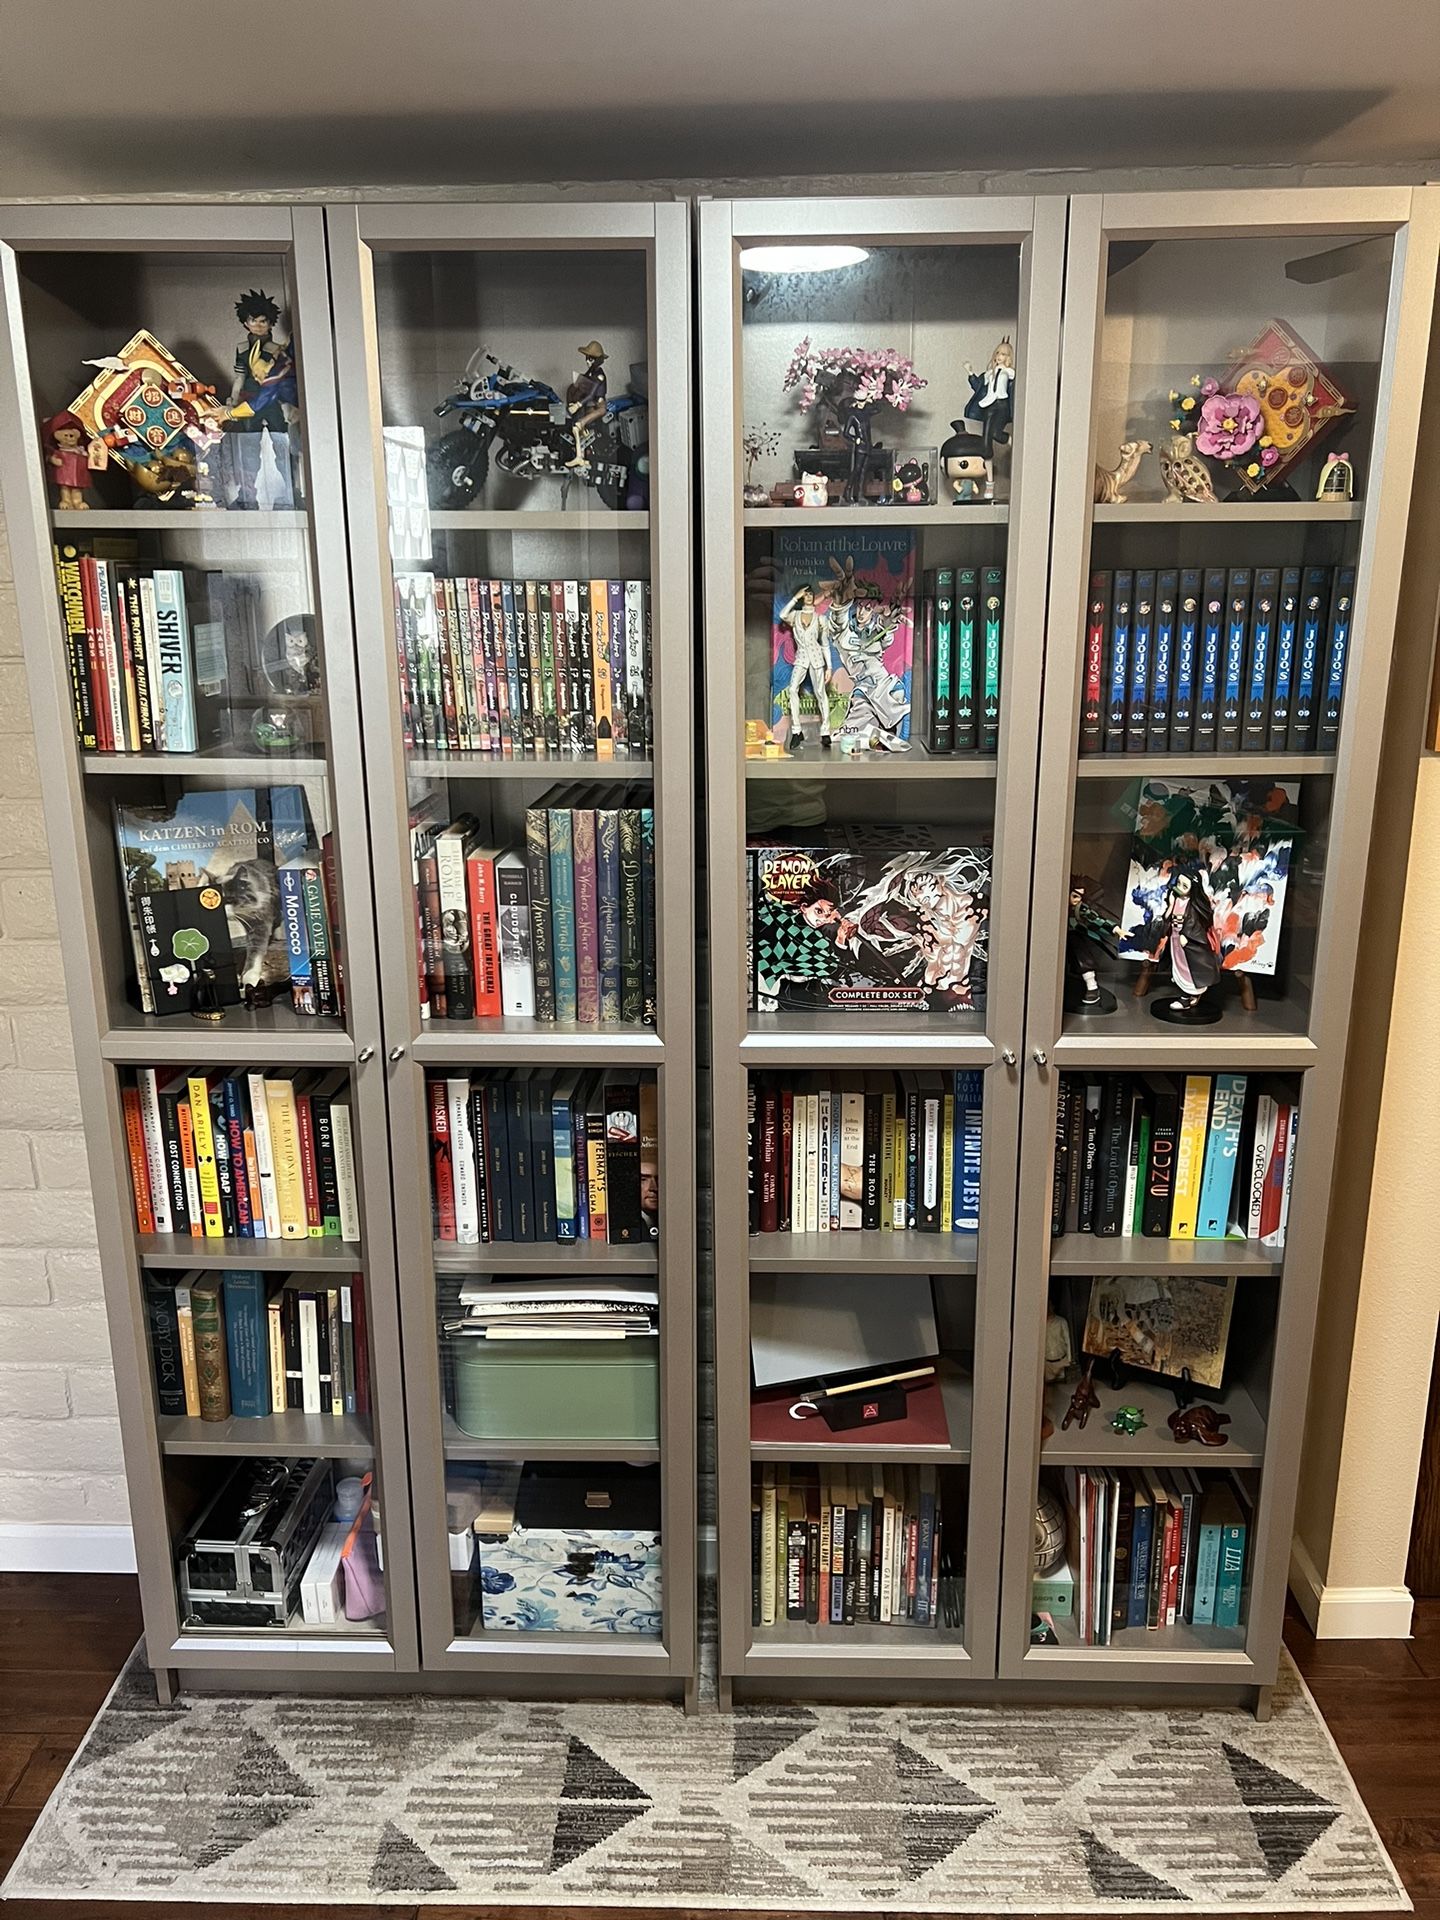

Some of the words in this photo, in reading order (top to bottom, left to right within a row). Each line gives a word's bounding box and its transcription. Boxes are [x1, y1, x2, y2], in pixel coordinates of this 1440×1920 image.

[780, 537, 821, 551] Rohan
[823, 538, 833, 551] at
[833, 537, 860, 551] the
[862, 537, 906, 551] Louvre
[785, 558, 824, 566] Hirohiko
[66, 562, 86, 633] WATCHMEN
[129, 595, 138, 616] THE
[98, 566, 107, 611] PEANUTS
[107, 645, 115, 678] FOREVER
[86, 628, 95, 657] MAUS
[130, 616, 143, 659] PROPHET
[157, 611, 182, 674] SHIVER
[938, 709, 948, 718] 01
[959, 709, 971, 717] 02
[985, 708, 997, 717] 03
[84, 735, 95, 746] DC
[138, 825, 206, 841] KATZEN
[211, 826, 225, 836] in
[229, 822, 267, 834] ROM
[171, 842, 214, 851] CIMITERO
[440, 854, 453, 899] ROME
[764, 860, 812, 873] DEMON
[621, 860, 640, 927] Dinosaurs
[762, 874, 812, 890] SLAYER
[307, 884, 321, 915] GAME
[285, 895, 301, 955] Morocco
[482, 912, 490, 925] THE
[531, 898, 549, 951] Universe
[553, 898, 574, 952] Animals
[601, 896, 617, 935] Aquatic
[312, 918, 326, 957] OVER
[484, 928, 492, 951] GREAT
[603, 935, 617, 955] Life
[485, 953, 495, 994] INFLUENZA
[836, 991, 881, 999] COMPLETE
[883, 991, 901, 999] BOX
[903, 991, 919, 999] SET
[193, 1085, 201, 1109] DAN
[433, 1085, 447, 1132] UNMASKED
[1056, 1080, 1066, 1119] HARPER
[1115, 1082, 1123, 1115] FARMER
[1184, 1088, 1197, 1131] DARK
[1211, 1089, 1229, 1129] END
[282, 1103, 290, 1126] THE
[765, 1101, 774, 1124] Blood
[783, 1108, 791, 1135] SOCK
[1195, 1099, 1207, 1127] THE
[1223, 1079, 1246, 1157] DEATH'S
[196, 1112, 207, 1149] ARIELY
[230, 1120, 242, 1149] HOW
[319, 1118, 330, 1148] BORN
[765, 1126, 775, 1163] Meridian
[964, 1109, 982, 1174] INFINITE
[1055, 1123, 1065, 1139] LEE
[1088, 1127, 1096, 1142] Tim
[1112, 1126, 1123, 1145] The
[169, 1140, 177, 1158] LOST
[233, 1153, 243, 1167] TO
[285, 1130, 296, 1182] RATIONAL
[868, 1154, 876, 1174] THE
[1087, 1143, 1096, 1170] O'Brien
[1109, 1146, 1121, 1168] Lord
[155, 1158, 164, 1195] CODDLING
[577, 1160, 585, 1187] LAWS
[595, 1142, 605, 1192] FERMAT'S
[1109, 1169, 1119, 1179] of
[1176, 1137, 1193, 1197] FOREST
[1251, 1144, 1265, 1217] OVERCLOCKED
[171, 1160, 184, 1211] CONNECTIONS
[235, 1169, 249, 1224] AMERICAN
[323, 1157, 334, 1209] DIGITAL
[963, 1180, 980, 1212] JEST
[1105, 1180, 1118, 1213] Opium
[155, 1301, 172, 1346] MOBY
[160, 1347, 176, 1383] DICK
[764, 1495, 772, 1543] BINYAVANGA
[834, 1515, 844, 1545] WRETCHED
[821, 1549, 829, 1566] APART
[833, 1556, 843, 1572] EARTH
[1224, 1547, 1242, 1572] LILA
[789, 1559, 799, 1600] MALCOLM
